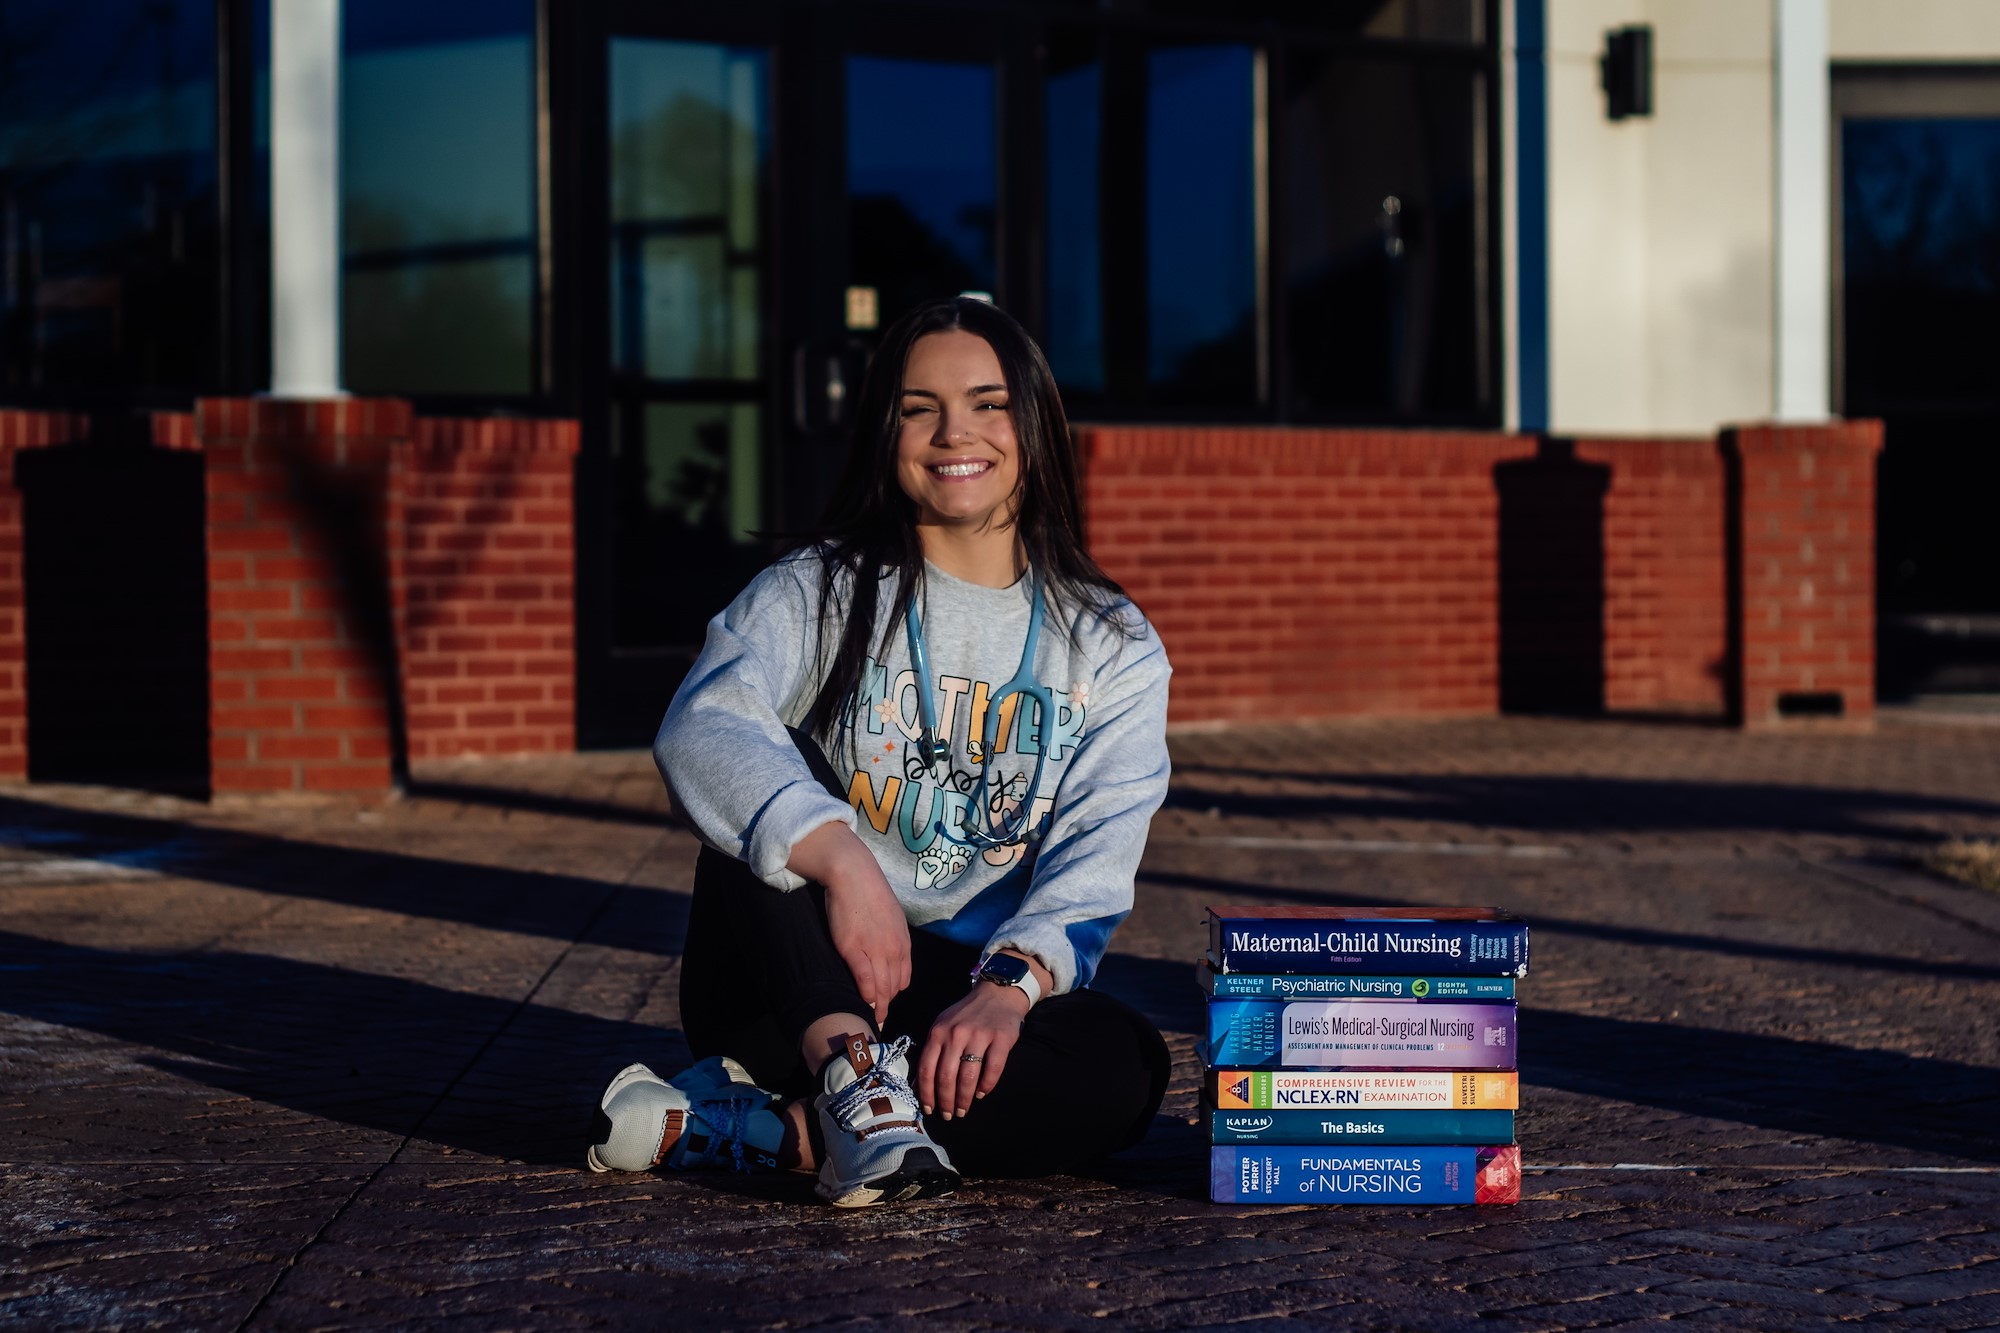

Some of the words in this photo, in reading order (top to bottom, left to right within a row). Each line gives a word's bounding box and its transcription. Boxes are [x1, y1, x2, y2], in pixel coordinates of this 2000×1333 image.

[839, 656, 1084, 760] MOTHER
[1231, 932, 1379, 953] Maternal-Child
[1384, 933, 1461, 957] Nursing
[1469, 933, 1478, 963] McKinney
[1485, 937, 1493, 959] Murray
[1272, 978, 1346, 994] Psychiatric
[1350, 979, 1402, 995] Nursing
[1230, 1013, 1239, 1054] HARDING
[1242, 1018, 1251, 1050] KWONG
[1253, 1016, 1262, 1051] HAGLER
[1265, 1011, 1274, 1056] REINISCH
[1289, 1017, 1329, 1035] Lewis's
[1332, 1017, 1427, 1039] Medical-Surgical
[1430, 1018, 1474, 1041] Nursing
[1437, 1043, 1445, 1051] 12
[1231, 1086, 1242, 1094] 8
[1277, 1079, 1371, 1088] COMPREHENSIVE
[1374, 1079, 1416, 1088] REVIEW
[1364, 1093, 1447, 1102] EXAMINATION
[1226, 1118, 1268, 1126] KAPLAN
[1321, 1122, 1343, 1133] The
[1346, 1122, 1385, 1133] Basics
[1242, 1157, 1250, 1193] POTTER
[1251, 1160, 1259, 1190] PERRY
[1301, 1159, 1421, 1171] FUNDAMENTALS
[1299, 1179, 1315, 1192] of
[1320, 1175, 1422, 1193] NURSING
